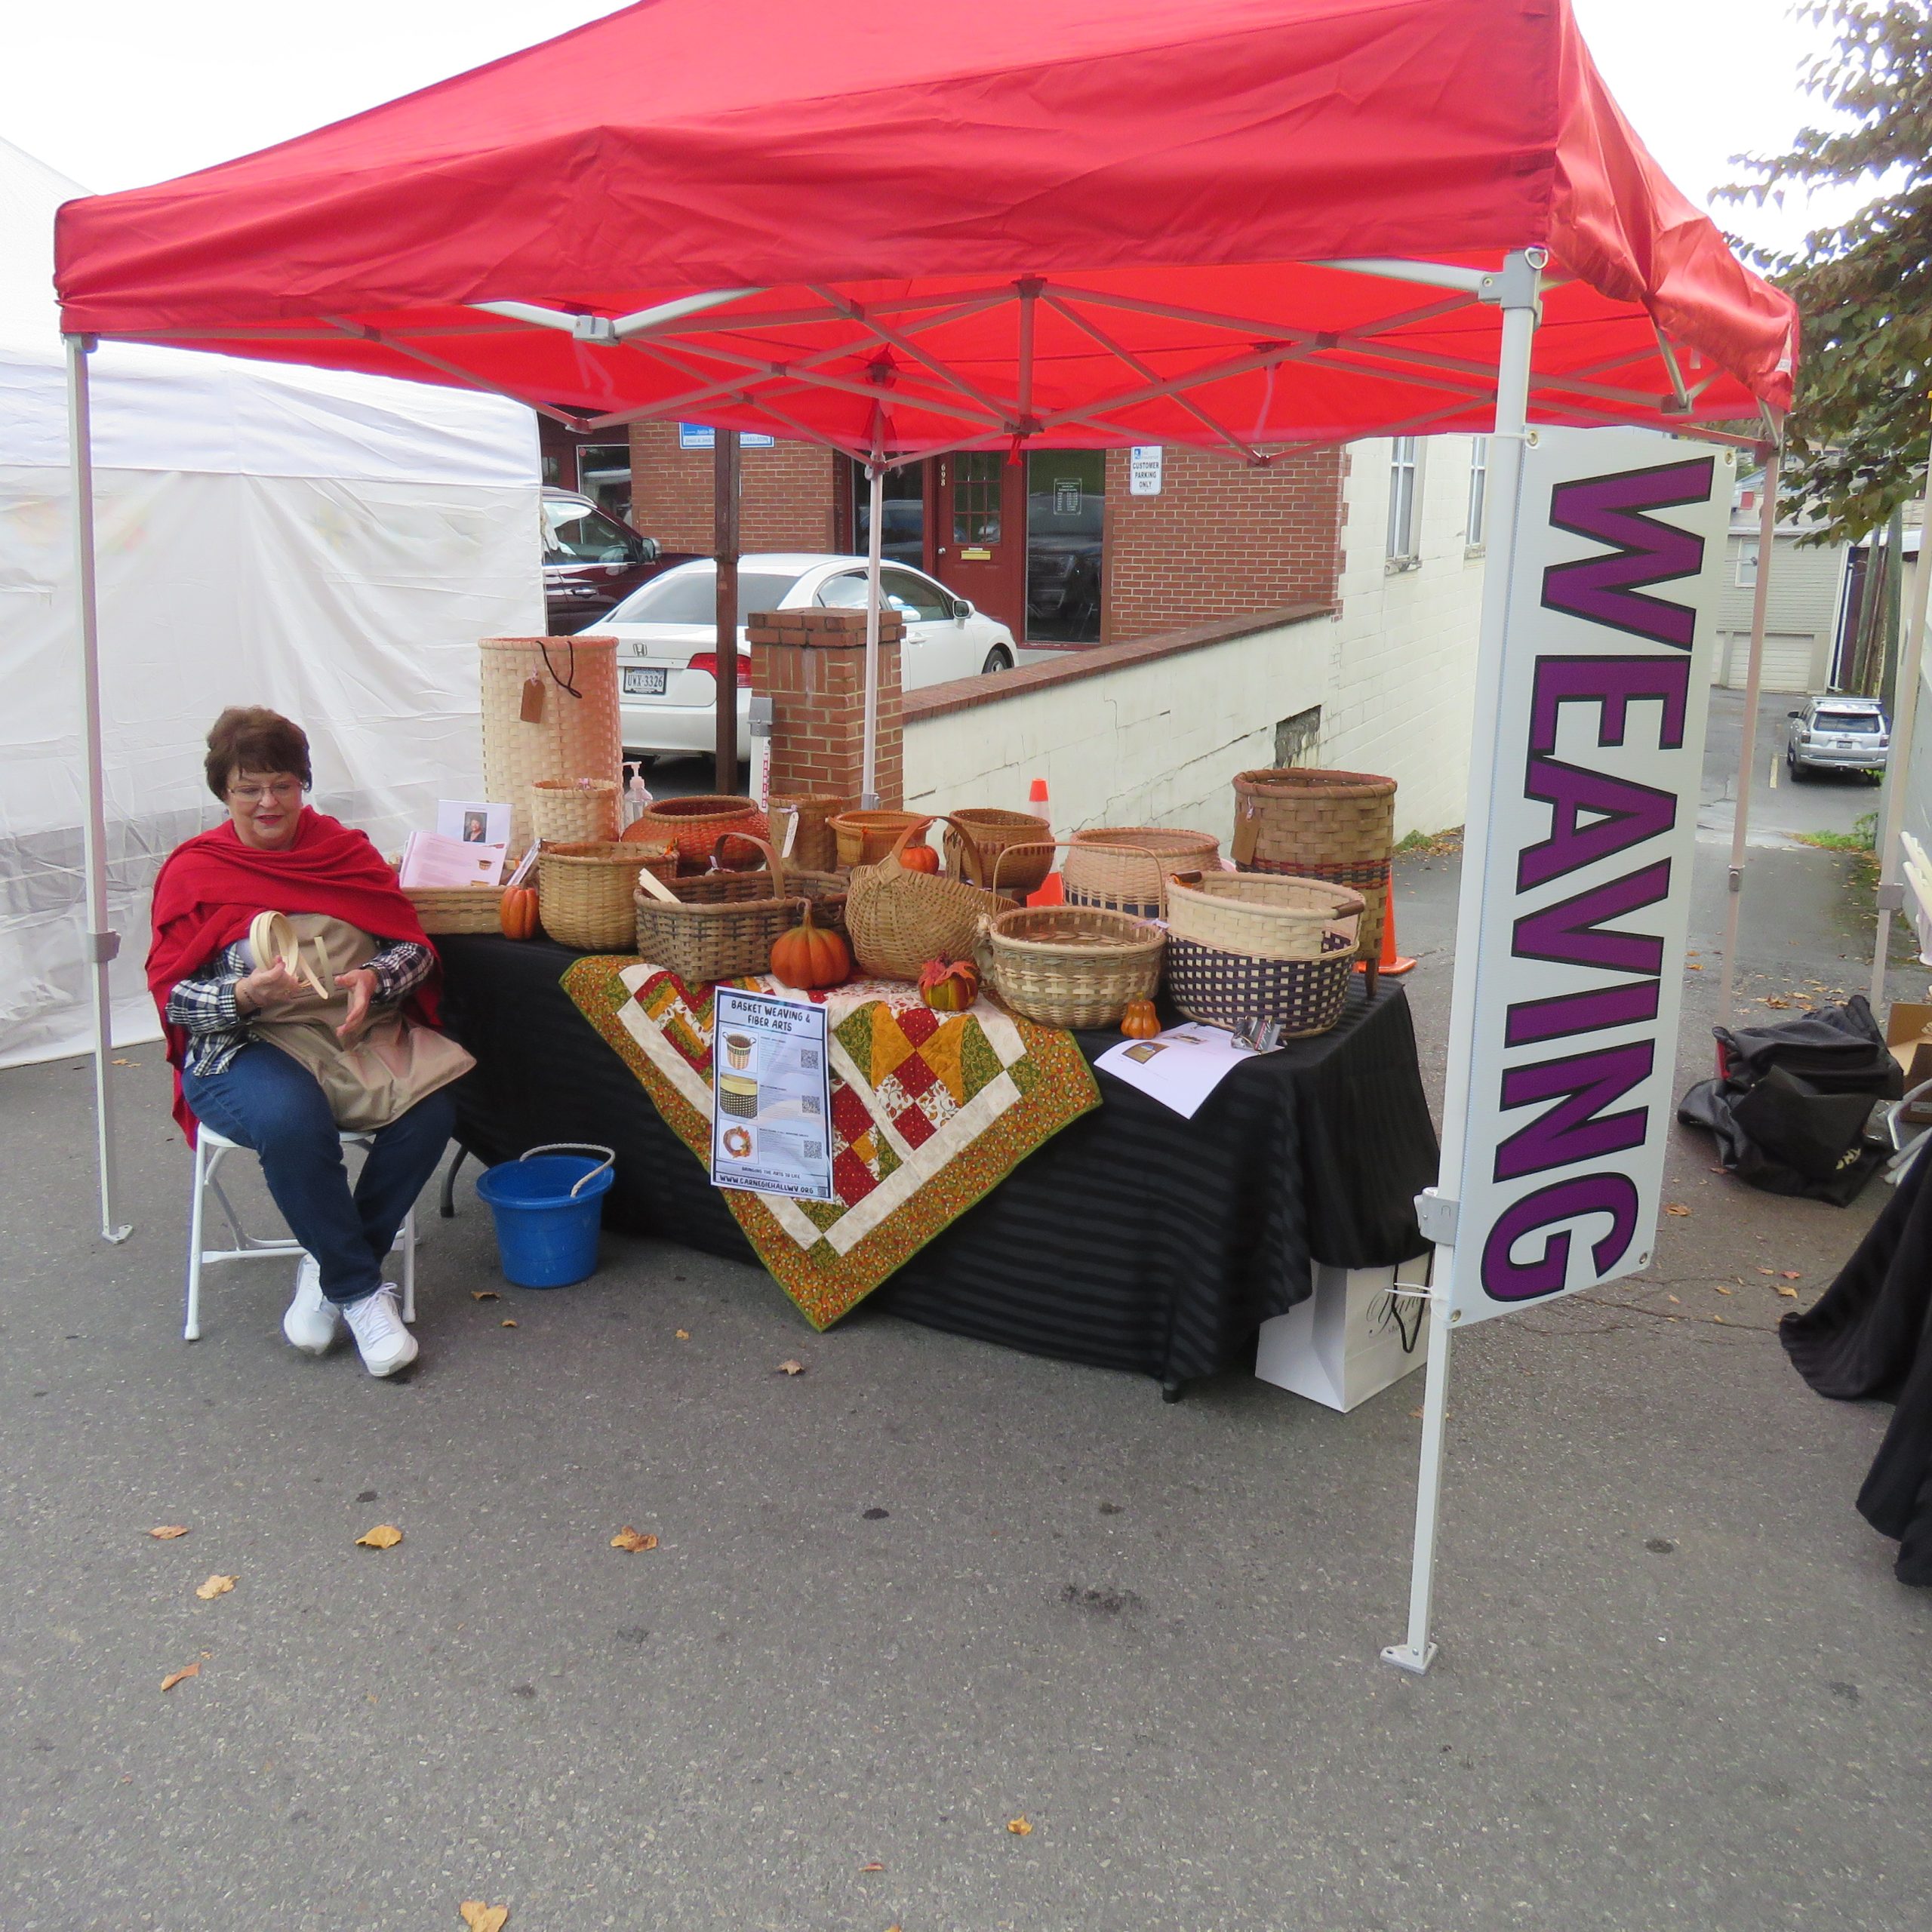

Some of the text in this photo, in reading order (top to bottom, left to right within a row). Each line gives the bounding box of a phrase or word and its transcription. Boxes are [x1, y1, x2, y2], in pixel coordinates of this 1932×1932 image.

[1481, 456, 1715, 1302] WEAVING
[731, 1000, 811, 1023] BASKET WEAVING &
[748, 1014, 792, 1032] FIBER ARTS
